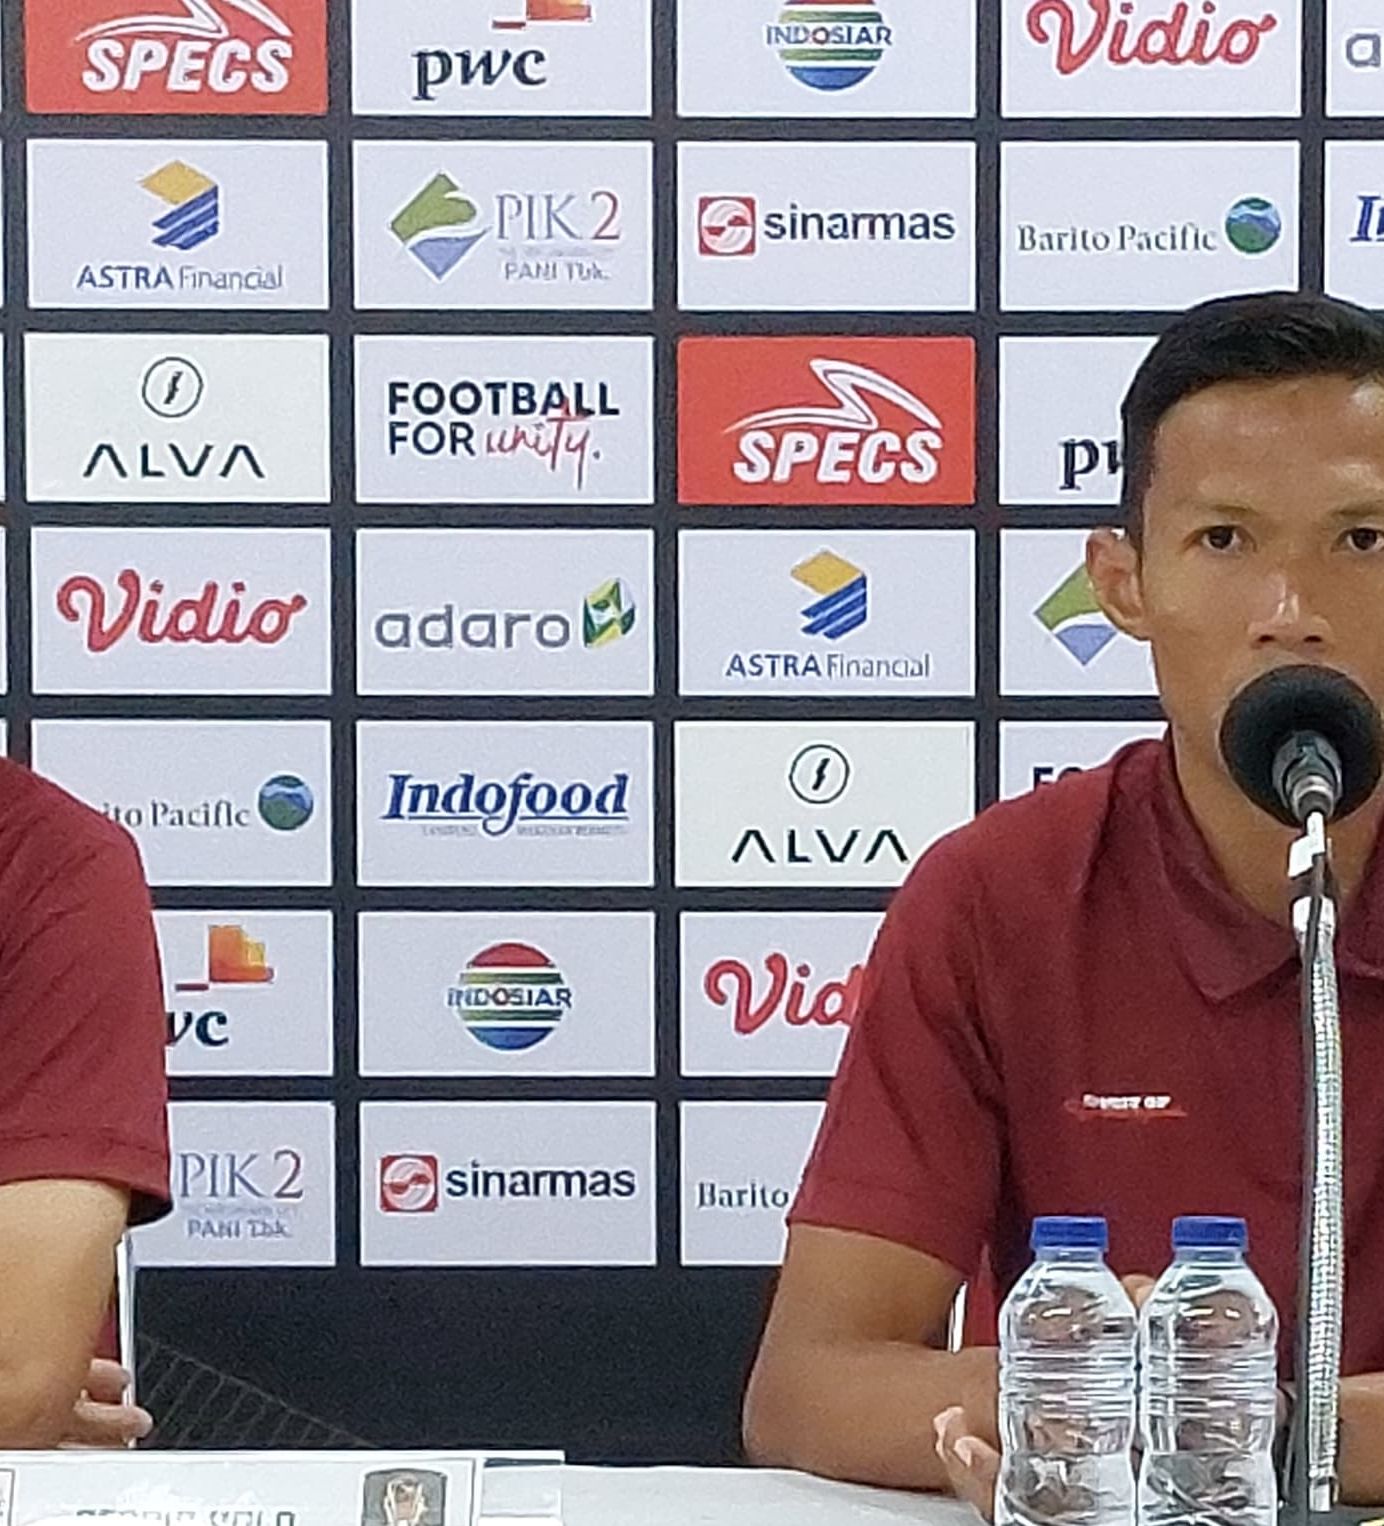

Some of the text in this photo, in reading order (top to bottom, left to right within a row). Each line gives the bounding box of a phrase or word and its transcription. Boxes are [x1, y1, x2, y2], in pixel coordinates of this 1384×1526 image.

[767, 24, 892, 45] INDOSIAR
[1026, 0, 1277, 75] Vidio
[82, 41, 293, 92] SPECS
[411, 49, 547, 101] pwc
[496, 191, 620, 240] PIK 2
[764, 203, 955, 240] sinarmas
[1017, 222, 1217, 252] Barito Pacific
[76, 264, 282, 290] ASTRA Financial
[388, 381, 620, 416] FOOTBALL
[388, 421, 475, 455] FOR
[83, 443, 265, 479] ALVA
[733, 430, 943, 484] SPECS
[57, 569, 307, 653] Vidio
[375, 604, 570, 649] adaro
[725, 653, 929, 679] ASTRA Financial
[151, 799, 250, 828] Pacific
[379, 772, 629, 837] Indofood
[731, 829, 910, 864] ALVA
[448, 987, 572, 1009] INDOSIAR
[703, 953, 866, 1034] Vid
[178, 1149, 303, 1199] PIK 2
[446, 1159, 635, 1199] sinarmas
[697, 1179, 789, 1210] Barito
